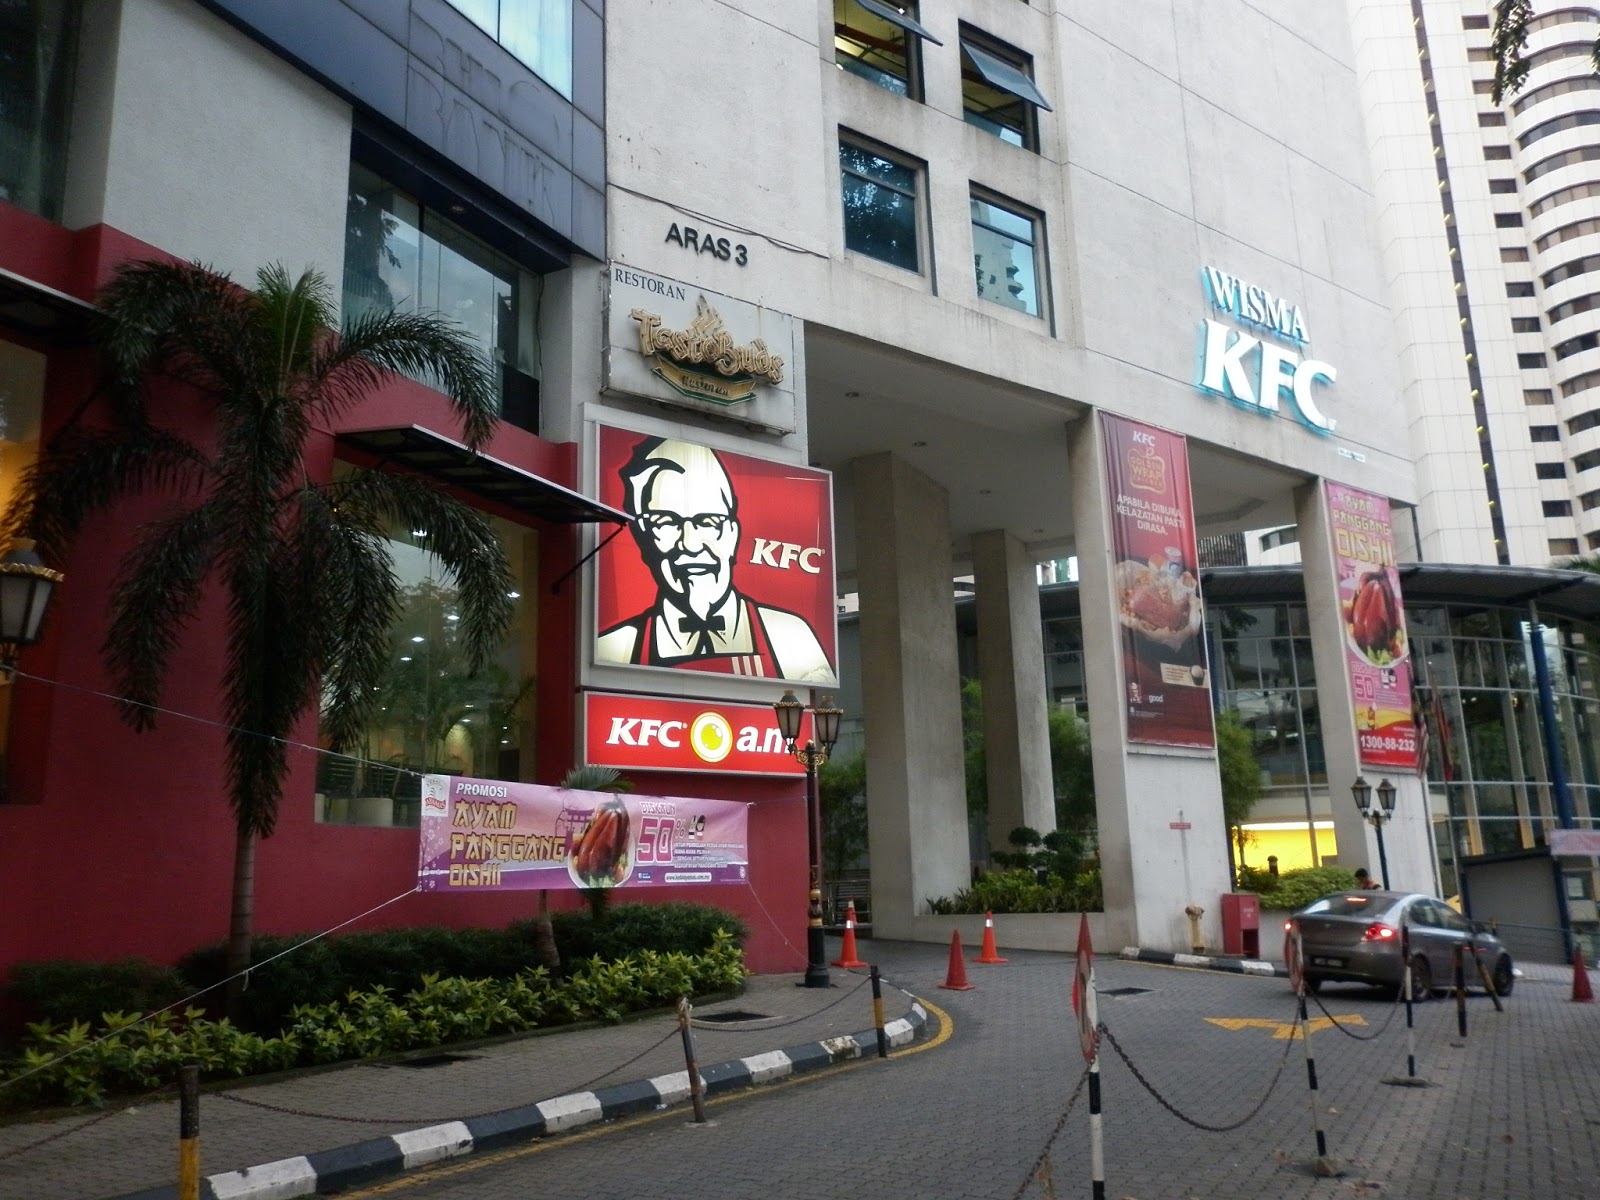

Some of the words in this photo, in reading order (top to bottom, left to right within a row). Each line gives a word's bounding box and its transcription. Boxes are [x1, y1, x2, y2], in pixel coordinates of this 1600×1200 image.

[665, 222, 731, 261] ARAS
[735, 244, 748, 266] 3
[614, 268, 686, 301] RESTORAN
[1203, 265, 1310, 344] WISMA
[1198, 318, 1337, 432] KFC
[1132, 431, 1156, 447] KFC
[1116, 504, 1163, 524] KELAZATAN
[1117, 494, 1151, 510] APABILA
[1333, 509, 1391, 536] PANGGANG
[750, 537, 823, 574] KFC
[1334, 528, 1394, 567] OISHII
[606, 717, 684, 748] KFC
[456, 783, 507, 798] PROMOSI
[452, 798, 517, 829] AYAM
[450, 831, 567, 862] PANGGANG
[449, 863, 501, 886] OISHII
